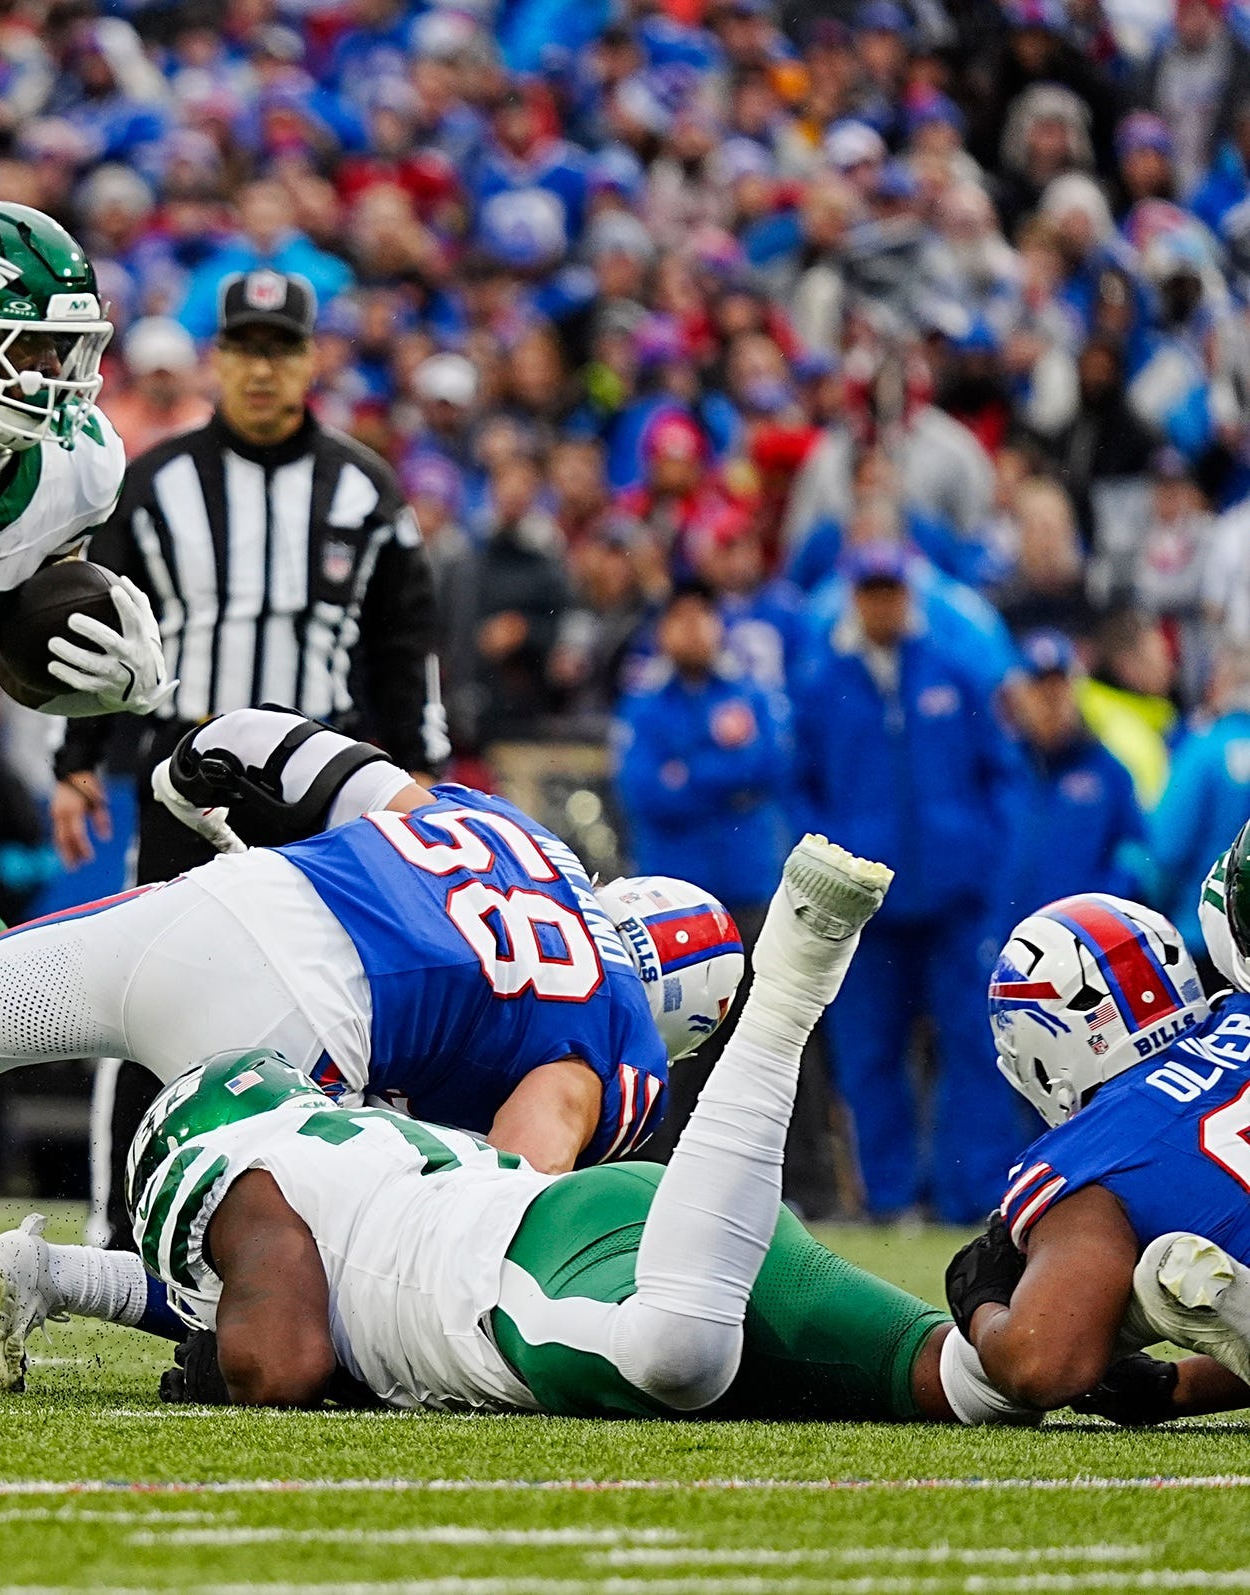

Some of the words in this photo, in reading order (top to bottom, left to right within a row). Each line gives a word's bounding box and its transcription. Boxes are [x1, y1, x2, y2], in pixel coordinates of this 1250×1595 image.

[362, 808, 605, 1003] 58
[532, 834, 634, 967] MILANO
[619, 916, 659, 984] BILLS
[1133, 1012, 1196, 1057] BILLS
[296, 1109, 522, 1177] 7
